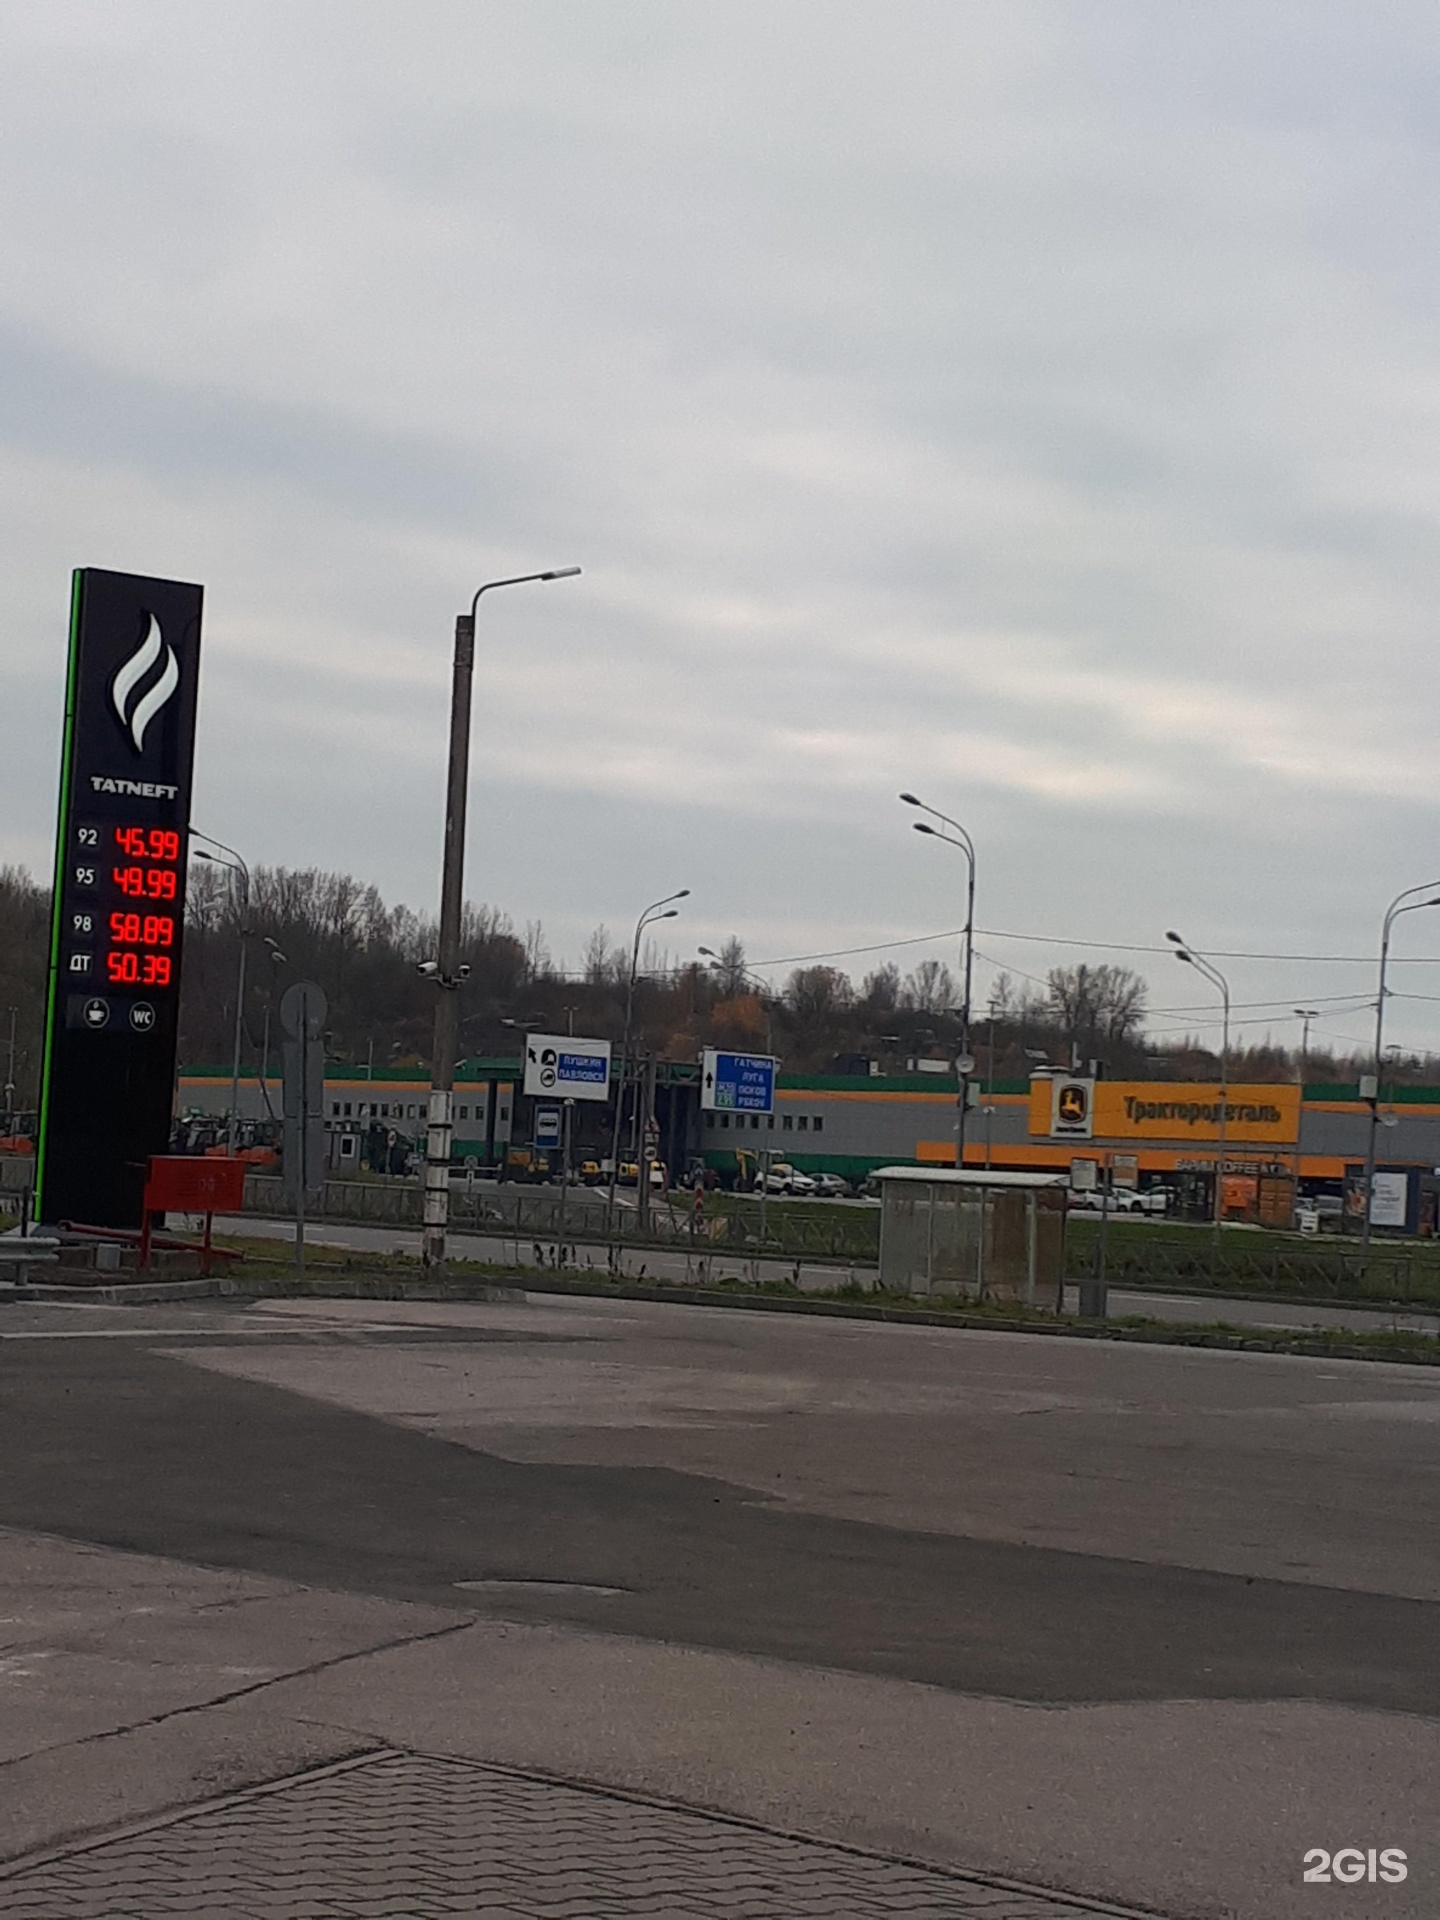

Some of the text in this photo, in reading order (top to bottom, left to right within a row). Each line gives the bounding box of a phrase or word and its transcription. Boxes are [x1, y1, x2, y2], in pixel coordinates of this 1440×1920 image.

[90, 776, 179, 800] TATNEFT
[78, 827, 179, 861] 92 45.99
[76, 866, 177, 900] 95 49.99
[73, 911, 174, 946] 98 58.89
[69, 951, 171, 985] ДТ 50.39
[133, 1010, 152, 1024] WC
[558, 1068, 606, 1083] ПАВЛОВСК
[734, 1057, 773, 1070] ГАТЧИНА
[742, 1071, 764, 1084] ЛУГА
[738, 1085, 766, 1097] ПСКОВ
[1123, 1095, 1281, 1126] Трактородеталь
